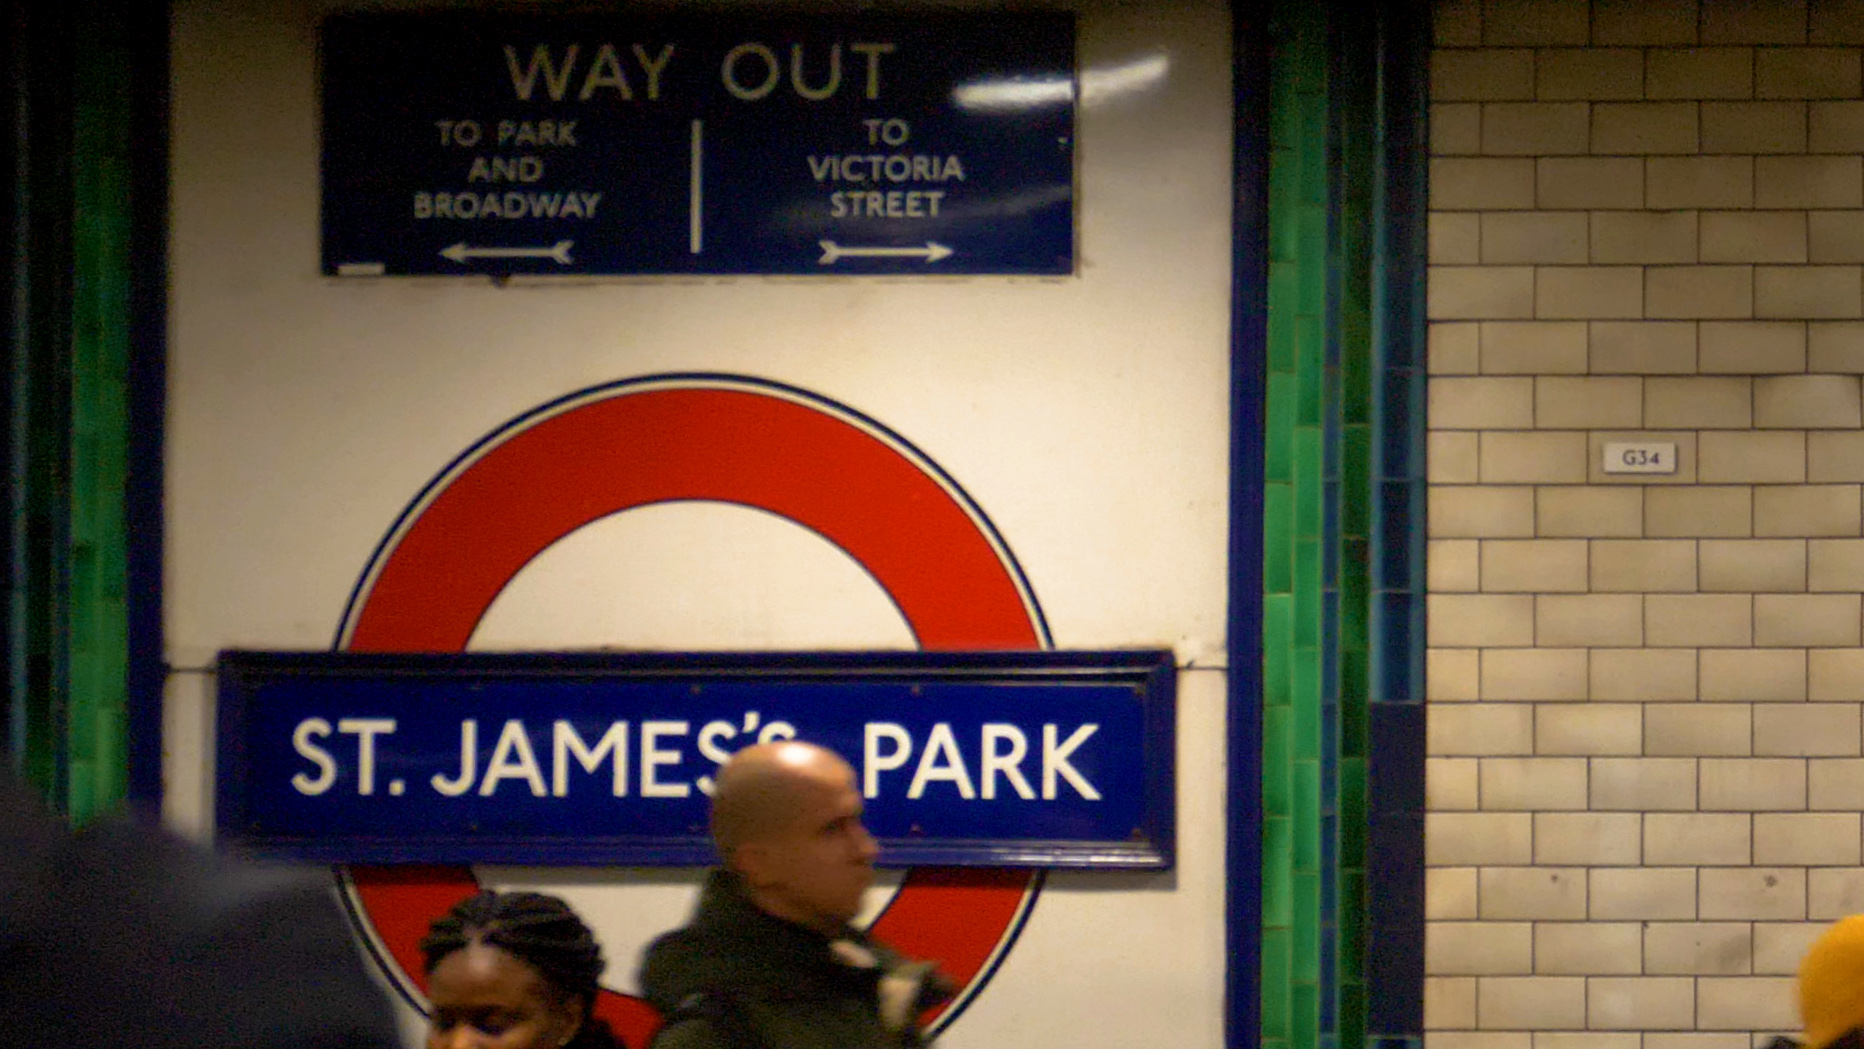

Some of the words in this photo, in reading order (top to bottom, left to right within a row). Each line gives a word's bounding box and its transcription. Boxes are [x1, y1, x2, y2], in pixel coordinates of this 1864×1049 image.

[505, 44, 675, 101] WAY
[722, 43, 894, 101] OUT
[436, 119, 481, 146] TO
[498, 120, 577, 146] PARK
[863, 119, 909, 146] TO
[468, 156, 543, 183] AND
[807, 154, 965, 182] VICTORIA
[413, 192, 601, 219] BROADWAY
[830, 191, 943, 218] STREET
[1622, 449, 1660, 466] G34
[291, 717, 406, 797] ST.
[432, 711, 797, 798] JAMES'
[863, 722, 1101, 800] PARK
